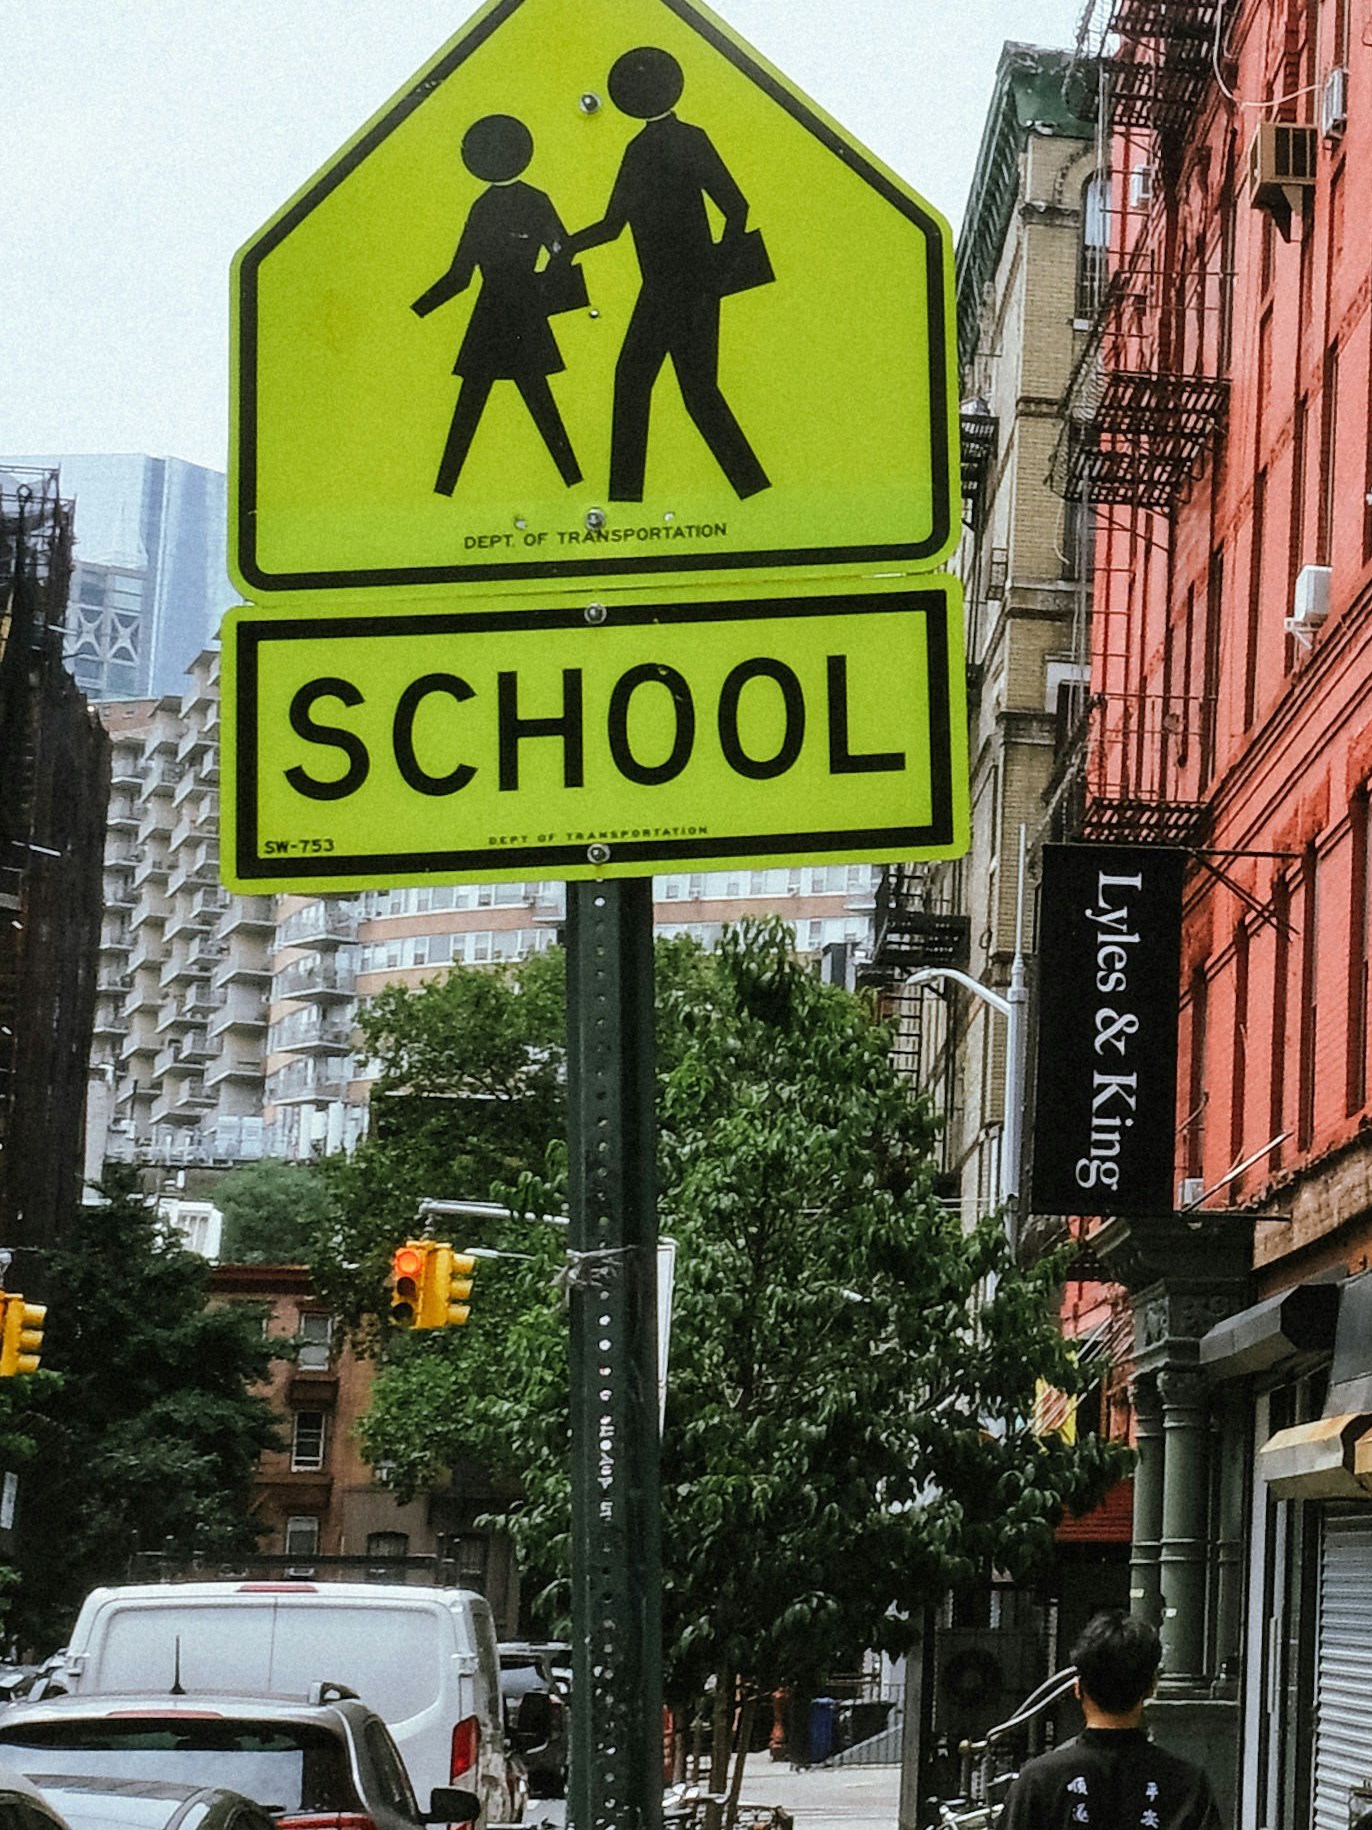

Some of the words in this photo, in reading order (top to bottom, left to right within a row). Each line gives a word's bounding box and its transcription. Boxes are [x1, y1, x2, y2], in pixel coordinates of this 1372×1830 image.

[463, 533, 515, 550] DEPT.
[523, 532, 548, 547] OF
[557, 522, 727, 545] TRANSPORTATION
[283, 653, 906, 802] SCHOOL
[263, 838, 335, 854] SW-753
[537, 832, 556, 843] OF
[566, 825, 709, 841] TRANSPORTATION
[1084, 869, 1143, 993] Lyles
[1093, 1007, 1140, 1056] &
[1075, 1069, 1138, 1192] King
